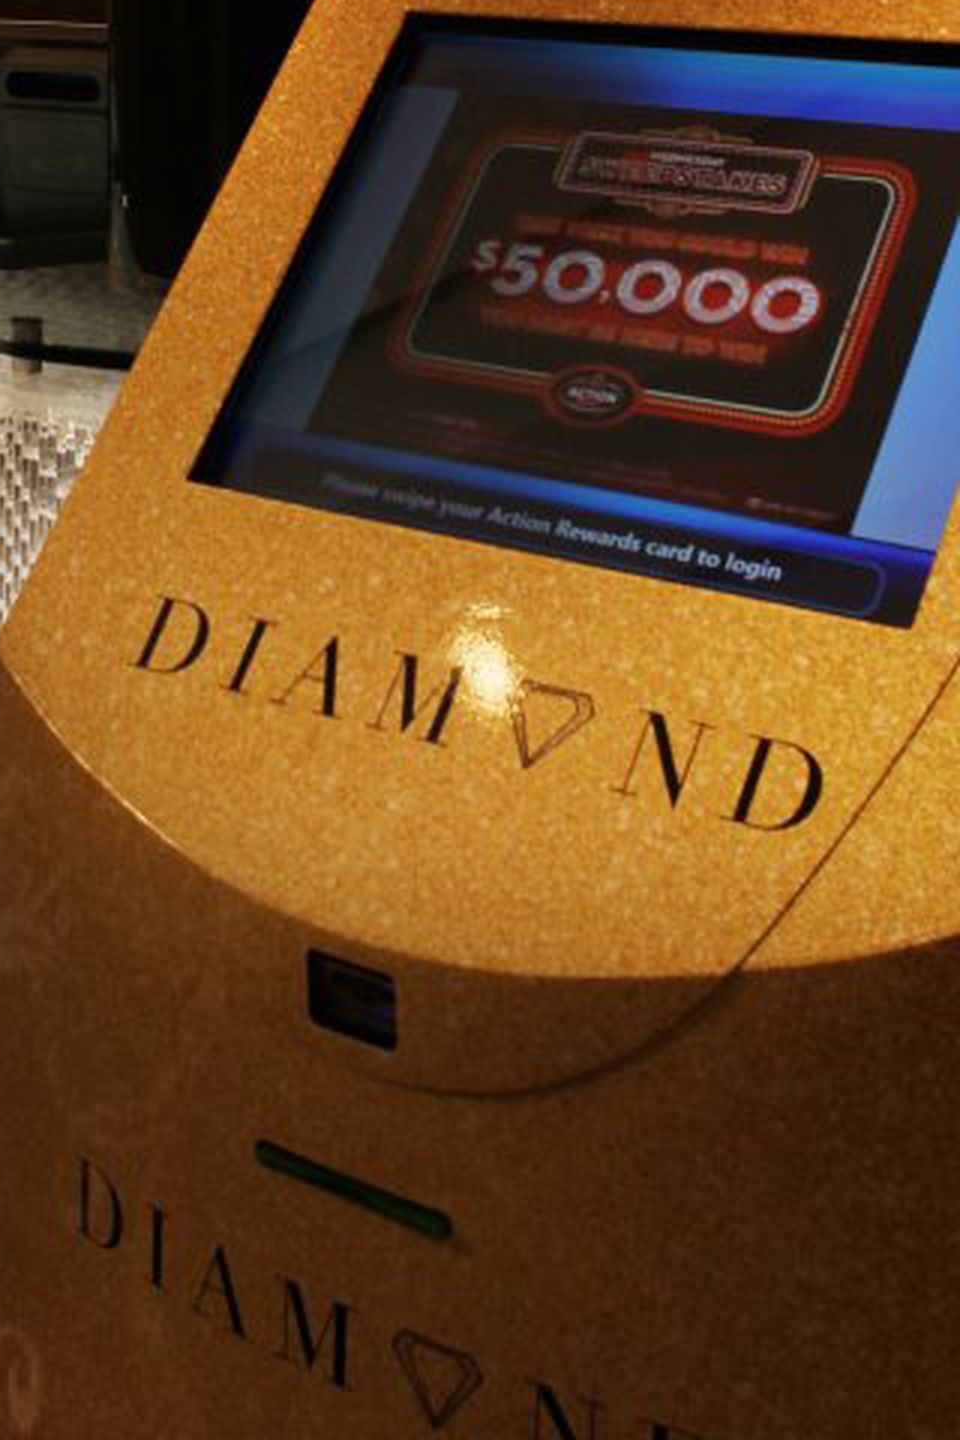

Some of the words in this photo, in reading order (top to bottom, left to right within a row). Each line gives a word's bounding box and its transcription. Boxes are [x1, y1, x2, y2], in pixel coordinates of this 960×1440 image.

[473, 238, 821, 334] $50,000
[487, 505, 551, 534] Action
[556, 518, 641, 552] Rewards
[645, 537, 694, 564] card
[697, 546, 720, 569] to
[725, 552, 783, 582] login
